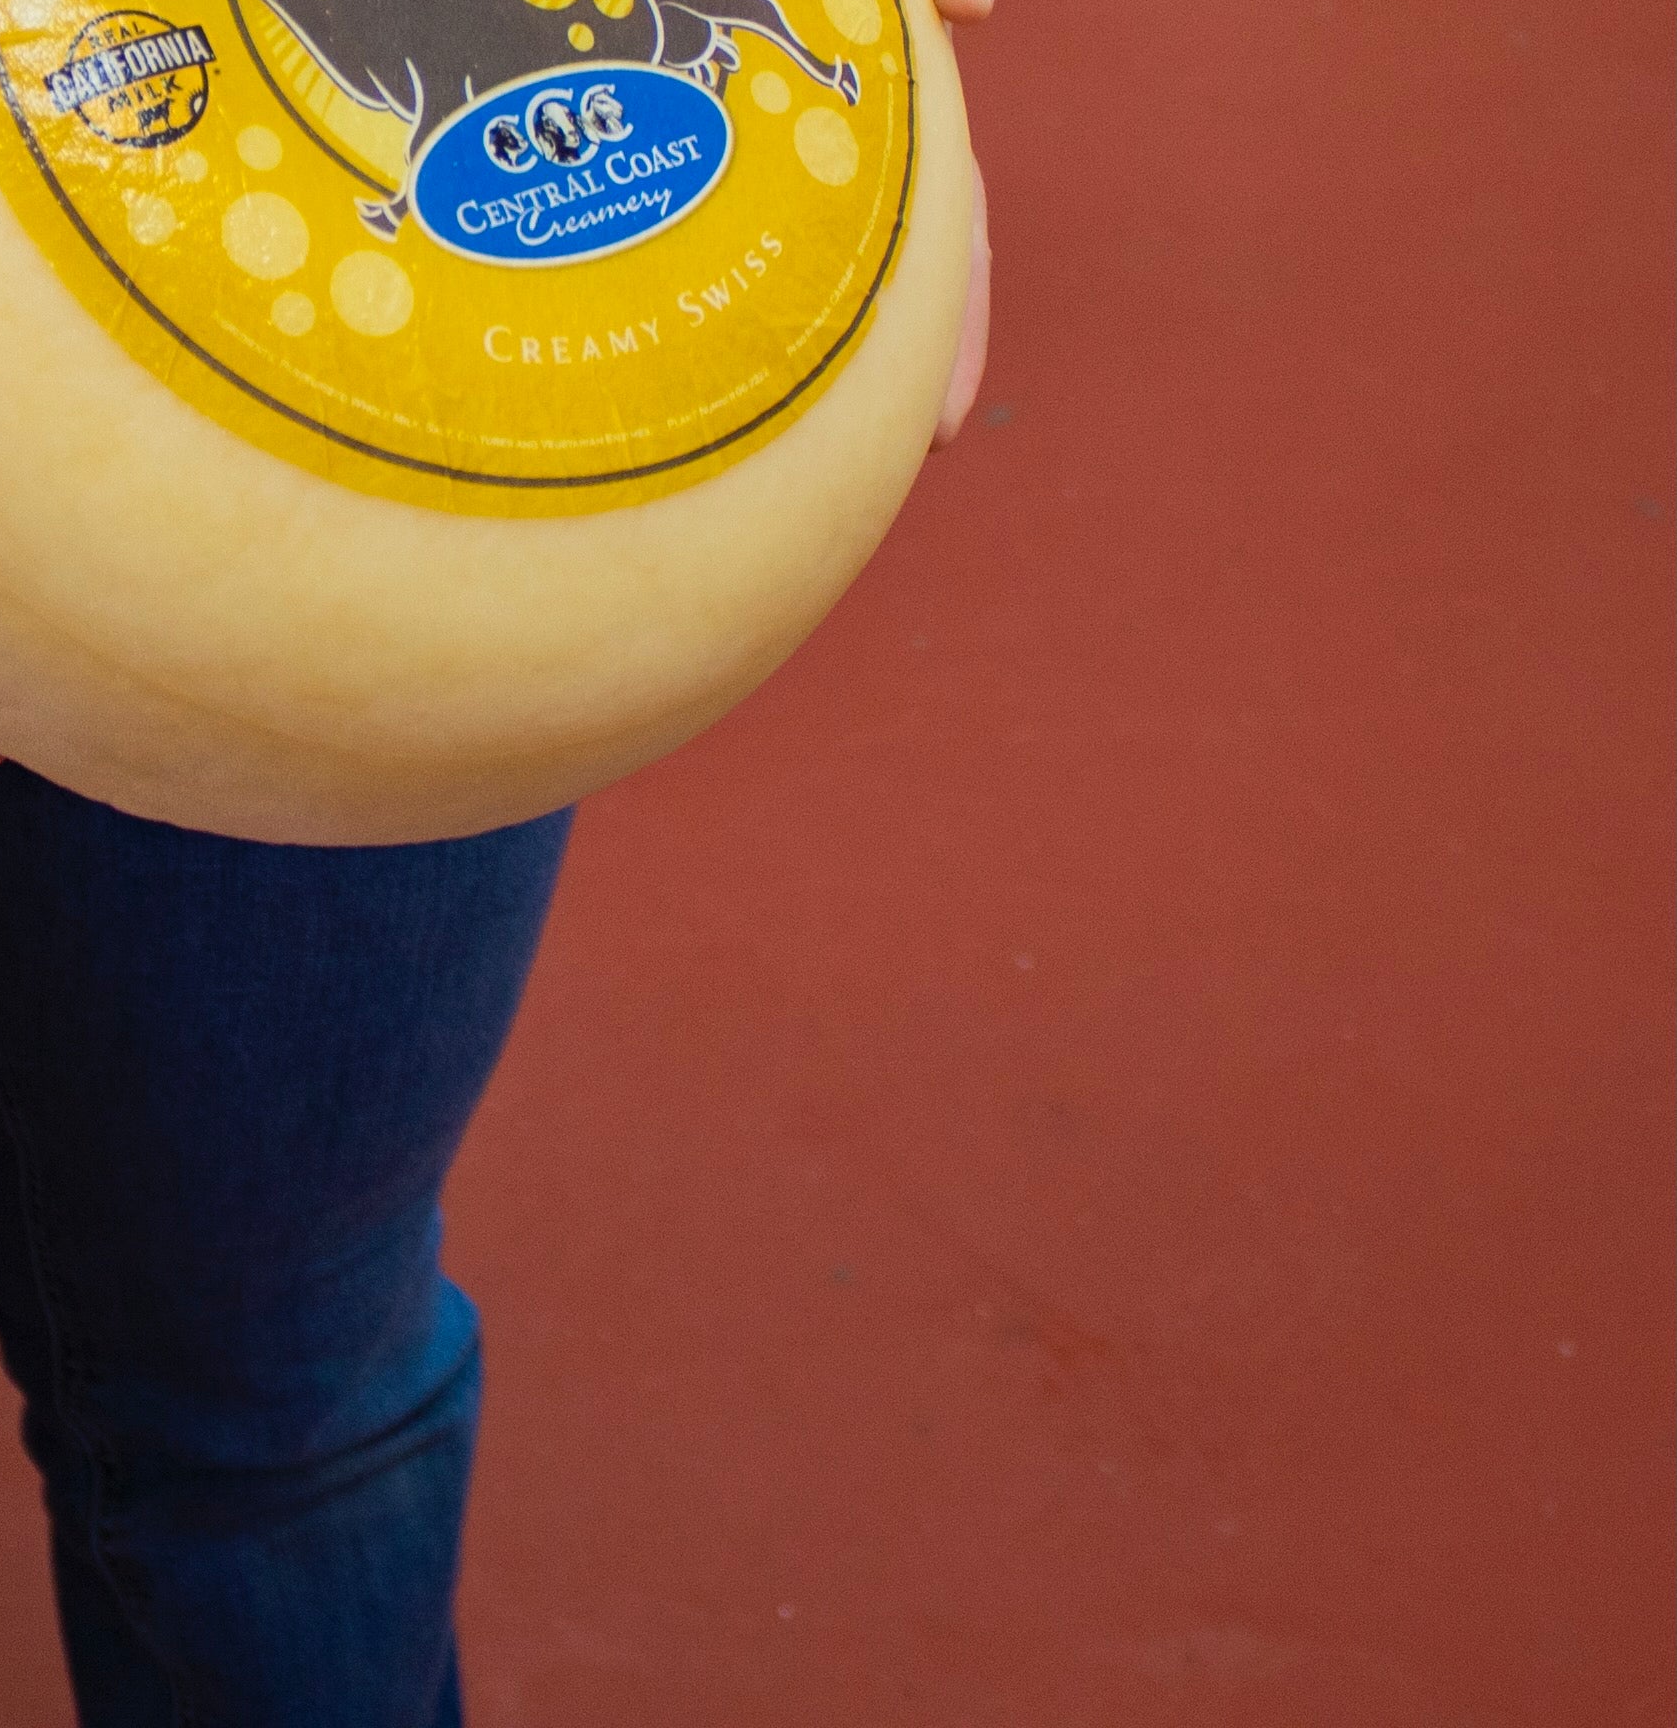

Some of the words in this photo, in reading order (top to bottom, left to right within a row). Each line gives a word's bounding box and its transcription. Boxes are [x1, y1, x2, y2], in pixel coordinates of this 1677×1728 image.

[51, 29, 211, 109] CALIFORNIA
[88, 22, 146, 49] REAL
[108, 74, 183, 112] MILK
[456, 170, 605, 235] CENTRAL
[605, 135, 702, 185] COAST
[516, 187, 673, 246] Creamery
[483, 318, 661, 363] CREAMY
[676, 231, 783, 328] SWISS
